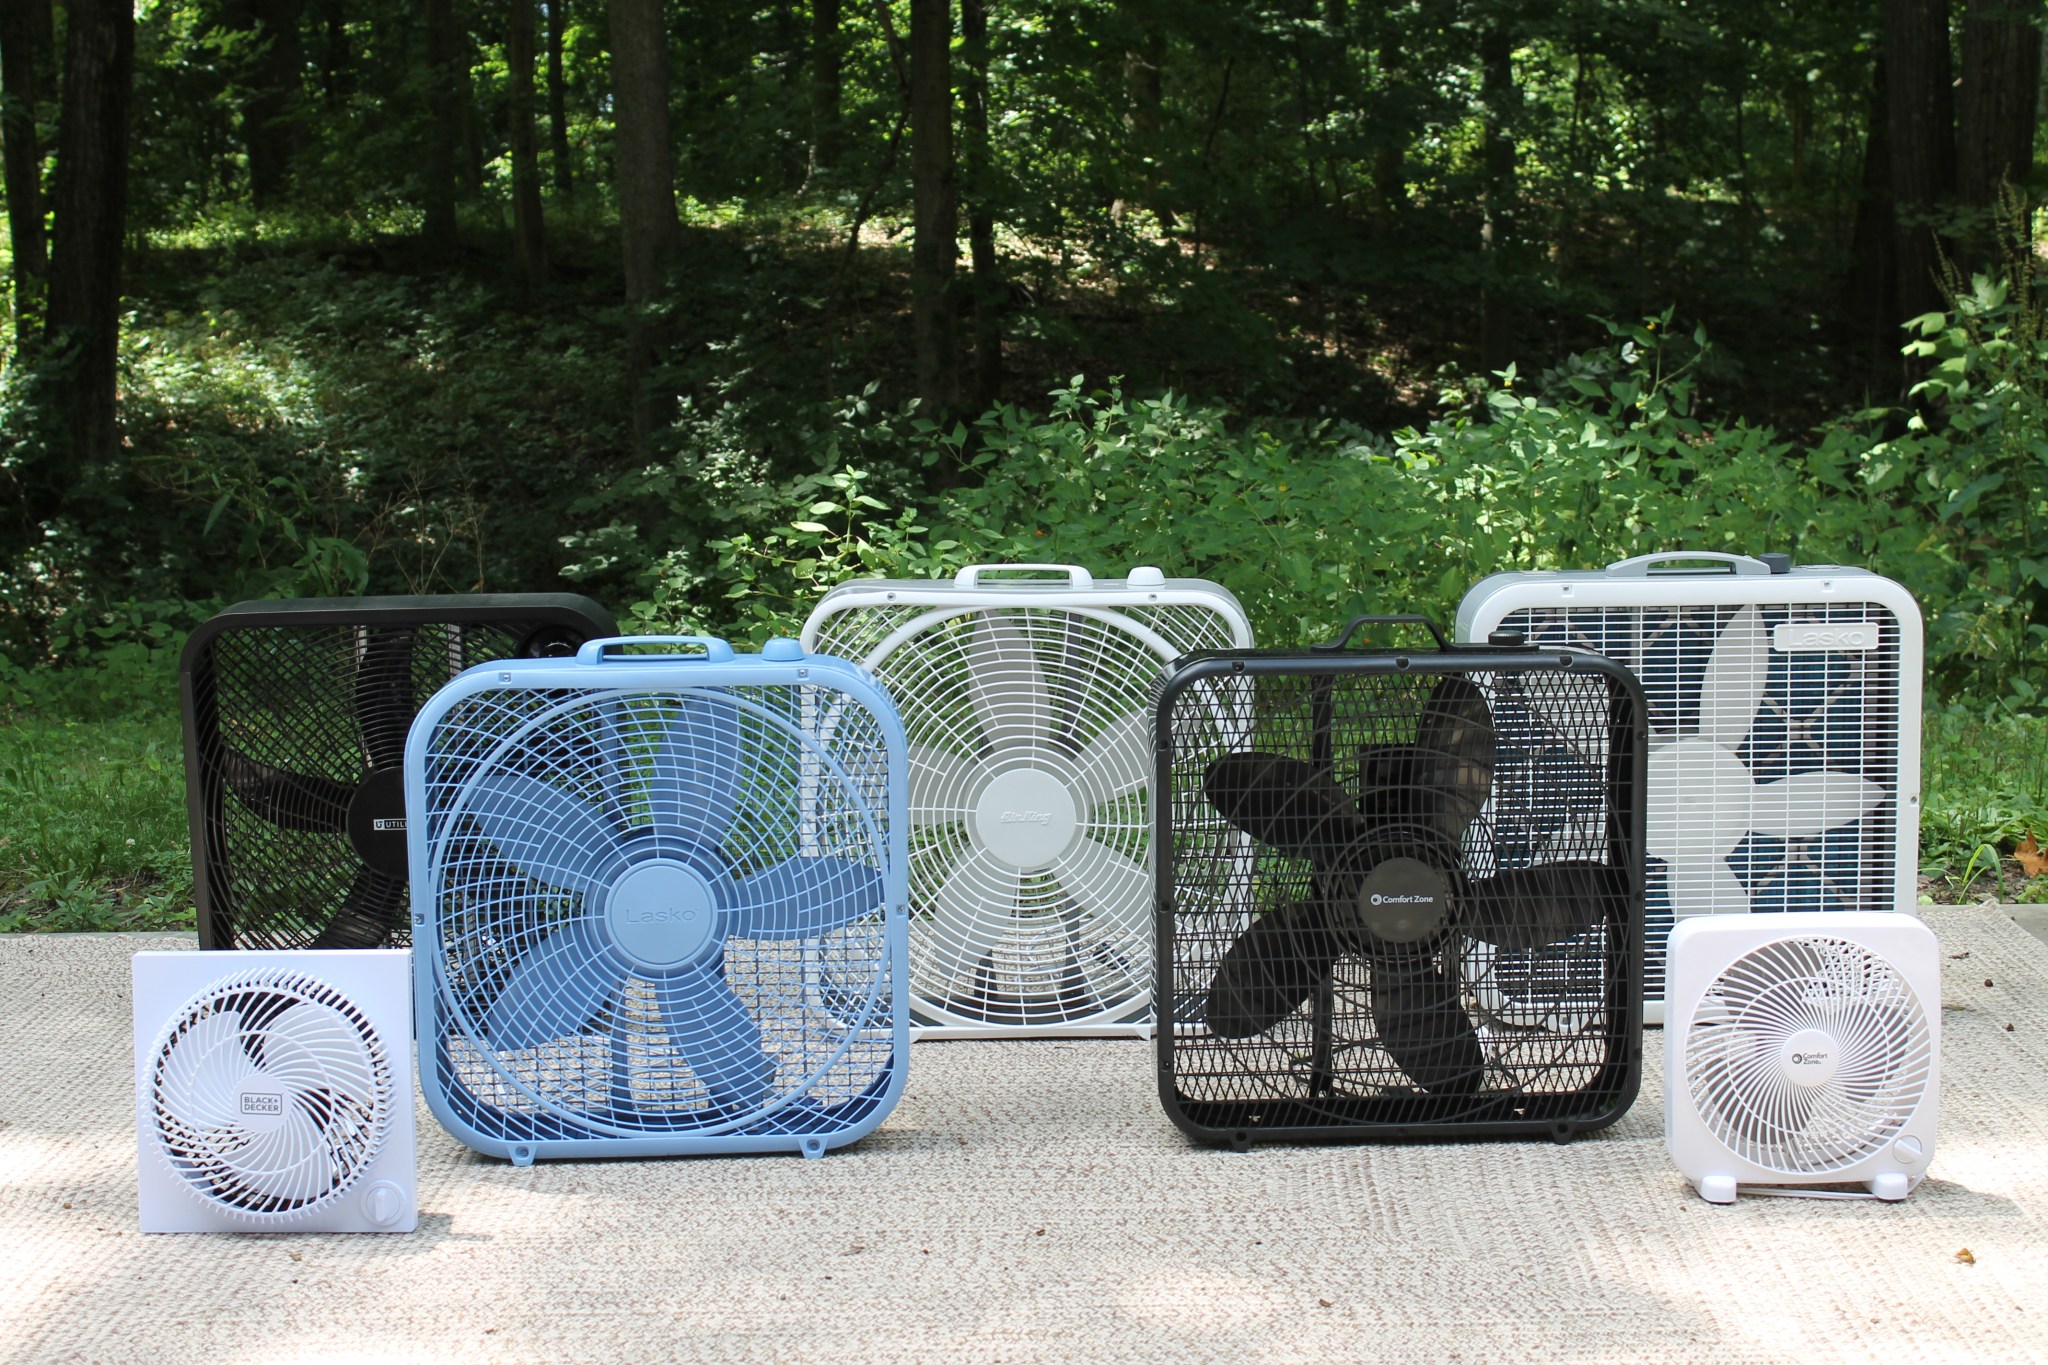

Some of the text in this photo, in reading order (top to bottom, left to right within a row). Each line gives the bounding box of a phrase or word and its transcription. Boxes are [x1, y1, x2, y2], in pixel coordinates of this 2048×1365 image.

[1788, 628, 1864, 647] Lasko
[1382, 895, 1434, 904] Comfort Zone
[625, 907, 696, 923] Lasko
[244, 1096, 278, 1104] BLACK+
